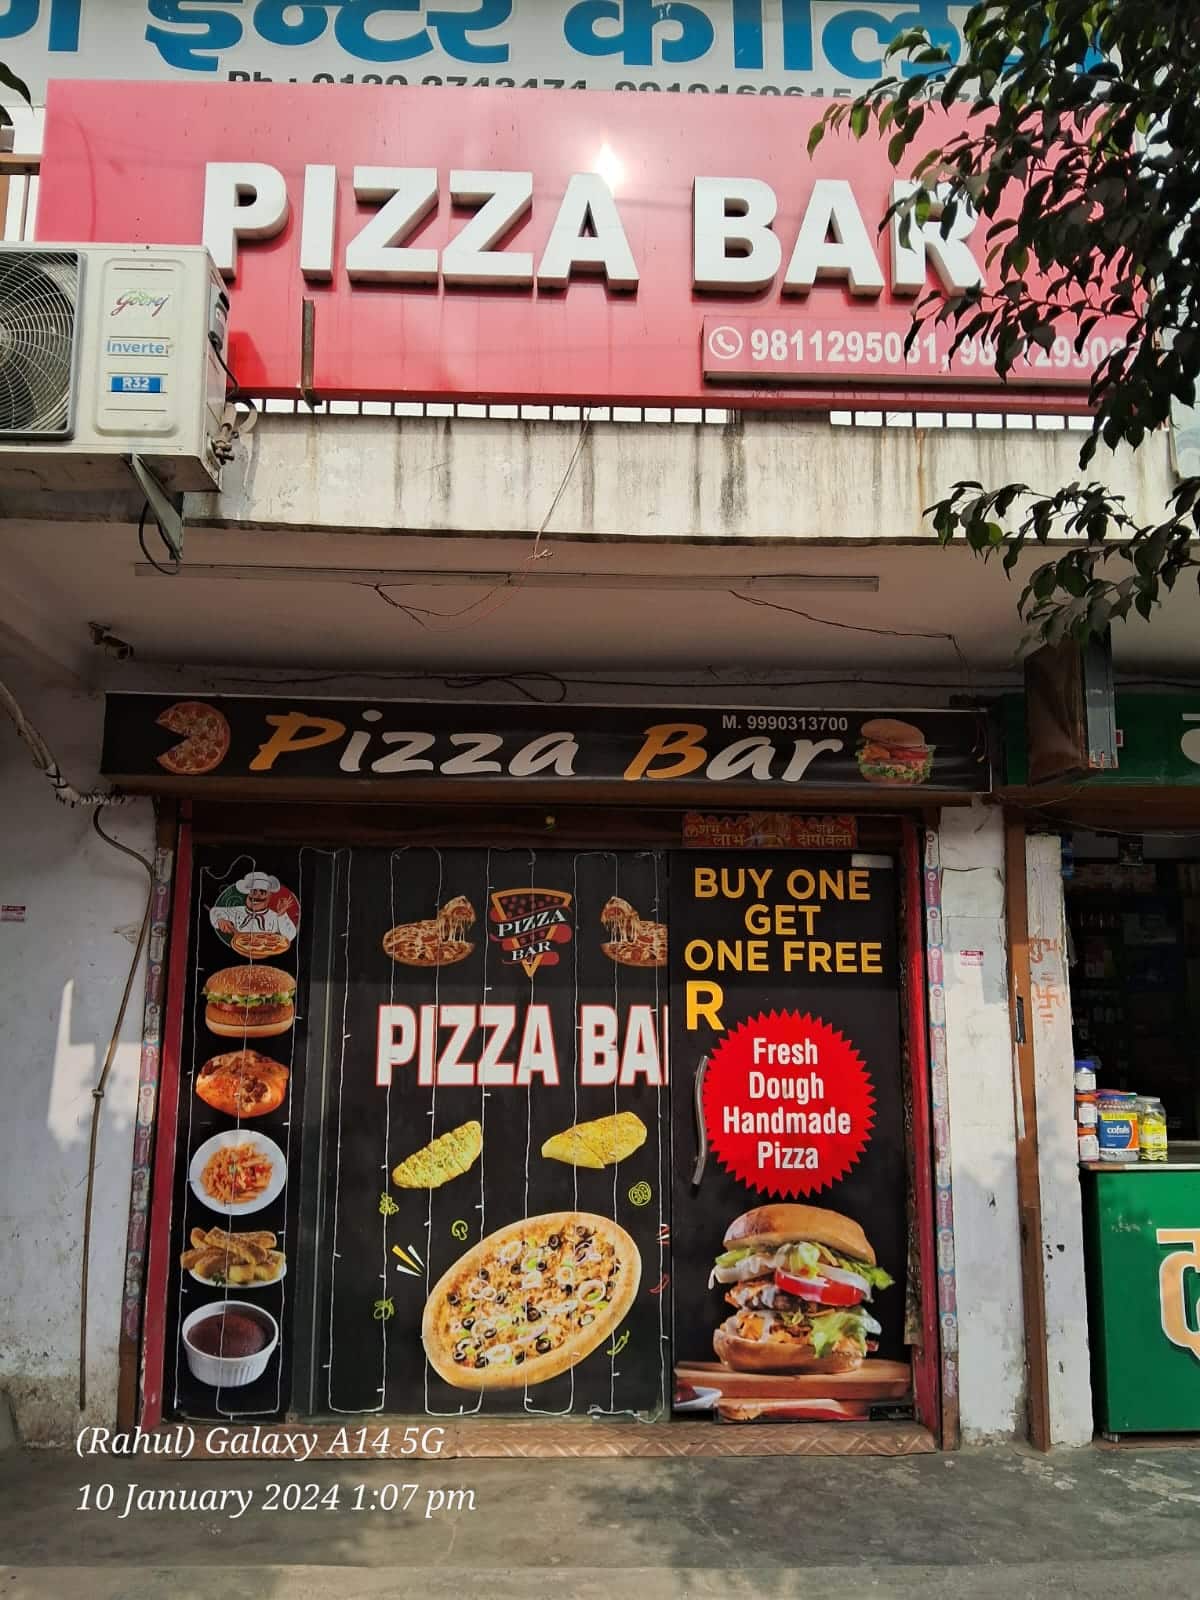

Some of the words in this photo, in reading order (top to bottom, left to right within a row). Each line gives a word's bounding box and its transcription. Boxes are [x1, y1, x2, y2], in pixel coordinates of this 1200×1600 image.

[202, 162, 638, 291] PIZZA
[692, 177, 984, 298] BAR
[106, 340, 173, 355] Inverter
[122, 377, 150, 391] R32
[721, 714, 742, 730] M.
[747, 715, 849, 732] 9990313700
[248, 710, 580, 777] Pizza
[623, 723, 844, 783] Bar
[694, 867, 773, 899] BUY
[786, 869, 871, 901] ONE
[497, 909, 568, 938] PIZZA
[744, 904, 821, 936] GET
[511, 940, 552, 962] BAR
[684, 939, 770, 972] ONE
[783, 941, 883, 974] FREE
[686, 980, 725, 1031] R
[375, 1004, 560, 1086] PIZZA
[580, 1004, 669, 1086] BA
[752, 1037, 819, 1066] Fresh
[748, 1071, 825, 1105] Dough
[722, 1106, 851, 1135] Handmade
[757, 1141, 819, 1169] Pizza
